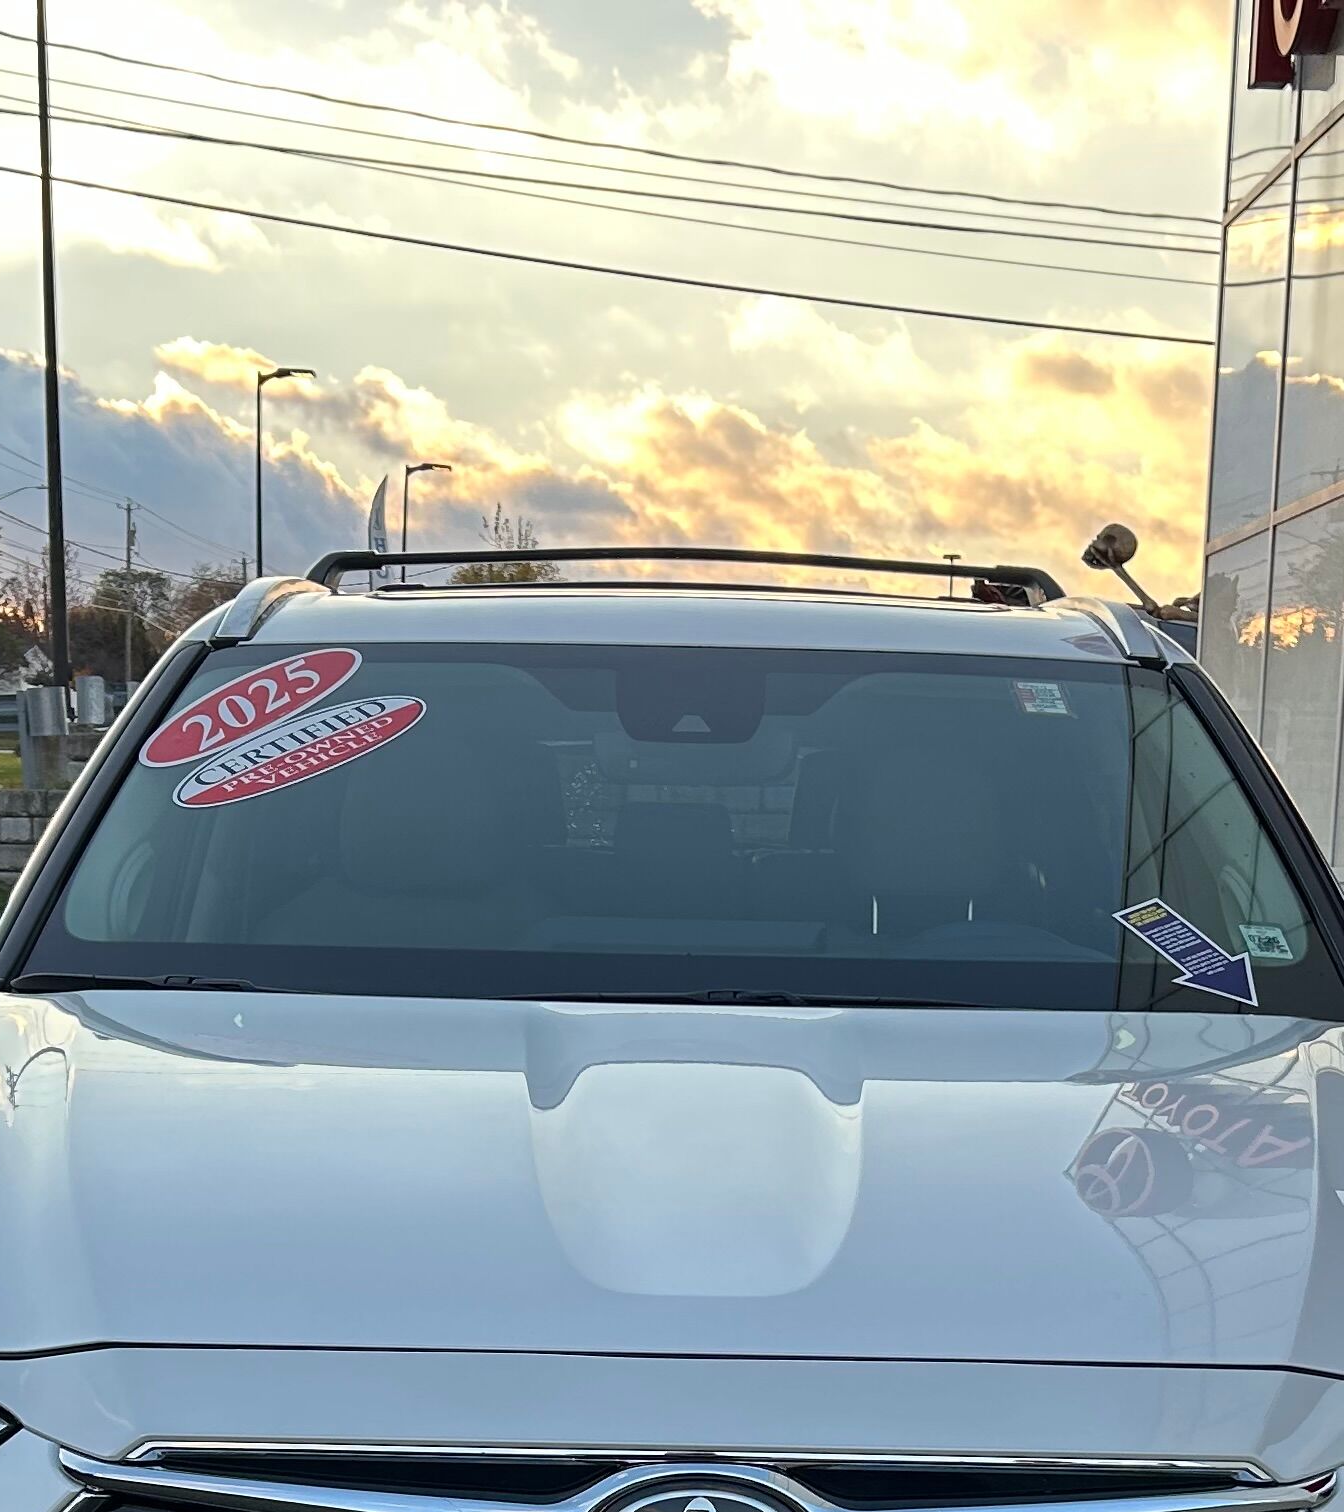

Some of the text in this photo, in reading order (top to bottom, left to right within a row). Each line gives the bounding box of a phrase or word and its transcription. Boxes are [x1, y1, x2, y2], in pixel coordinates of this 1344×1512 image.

[182, 658, 322, 752] 2025
[194, 700, 387, 787] CERTIFIED
[221, 715, 394, 793] PRE-OWNED
[256, 730, 385, 785] VEHICLE
